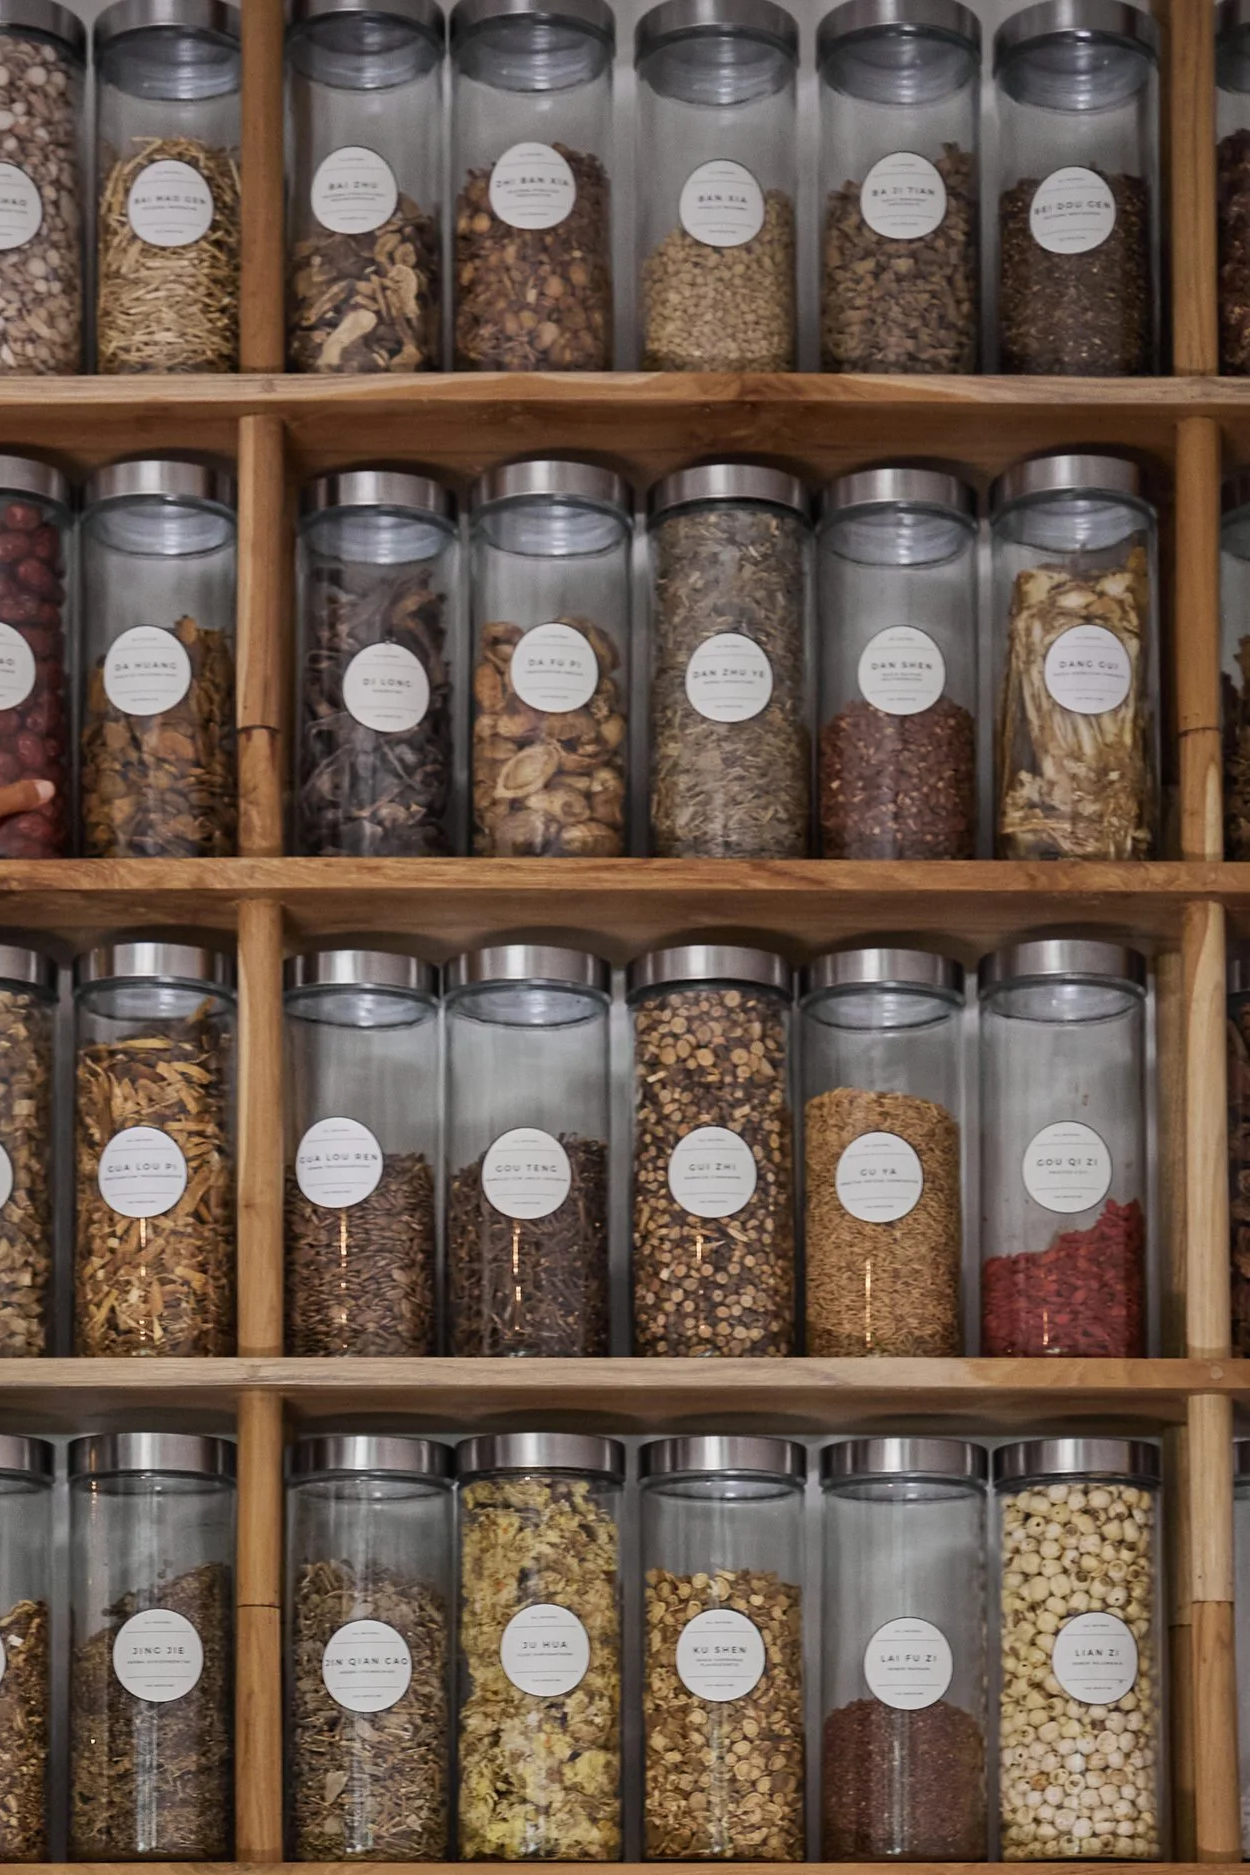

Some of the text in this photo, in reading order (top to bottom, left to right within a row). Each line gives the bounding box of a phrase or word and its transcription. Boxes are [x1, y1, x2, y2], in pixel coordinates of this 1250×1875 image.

[300, 1155, 320, 1164] GUA
[326, 1153, 349, 1161] LOU
[1037, 1158, 1098, 1166] GOU QI ZI
[108, 1164, 130, 1172] GUA
[136, 1163, 160, 1171] LOU
[496, 1164, 557, 1172] GOU TENG
[689, 1162, 736, 1171] GUI ZHI
[132, 1647, 162, 1655] JING
[714, 1646, 746, 1654] SHEN
[1075, 1649, 1103, 1657] LIAN
[326, 1657, 408, 1666] JIN QIAN CAO
